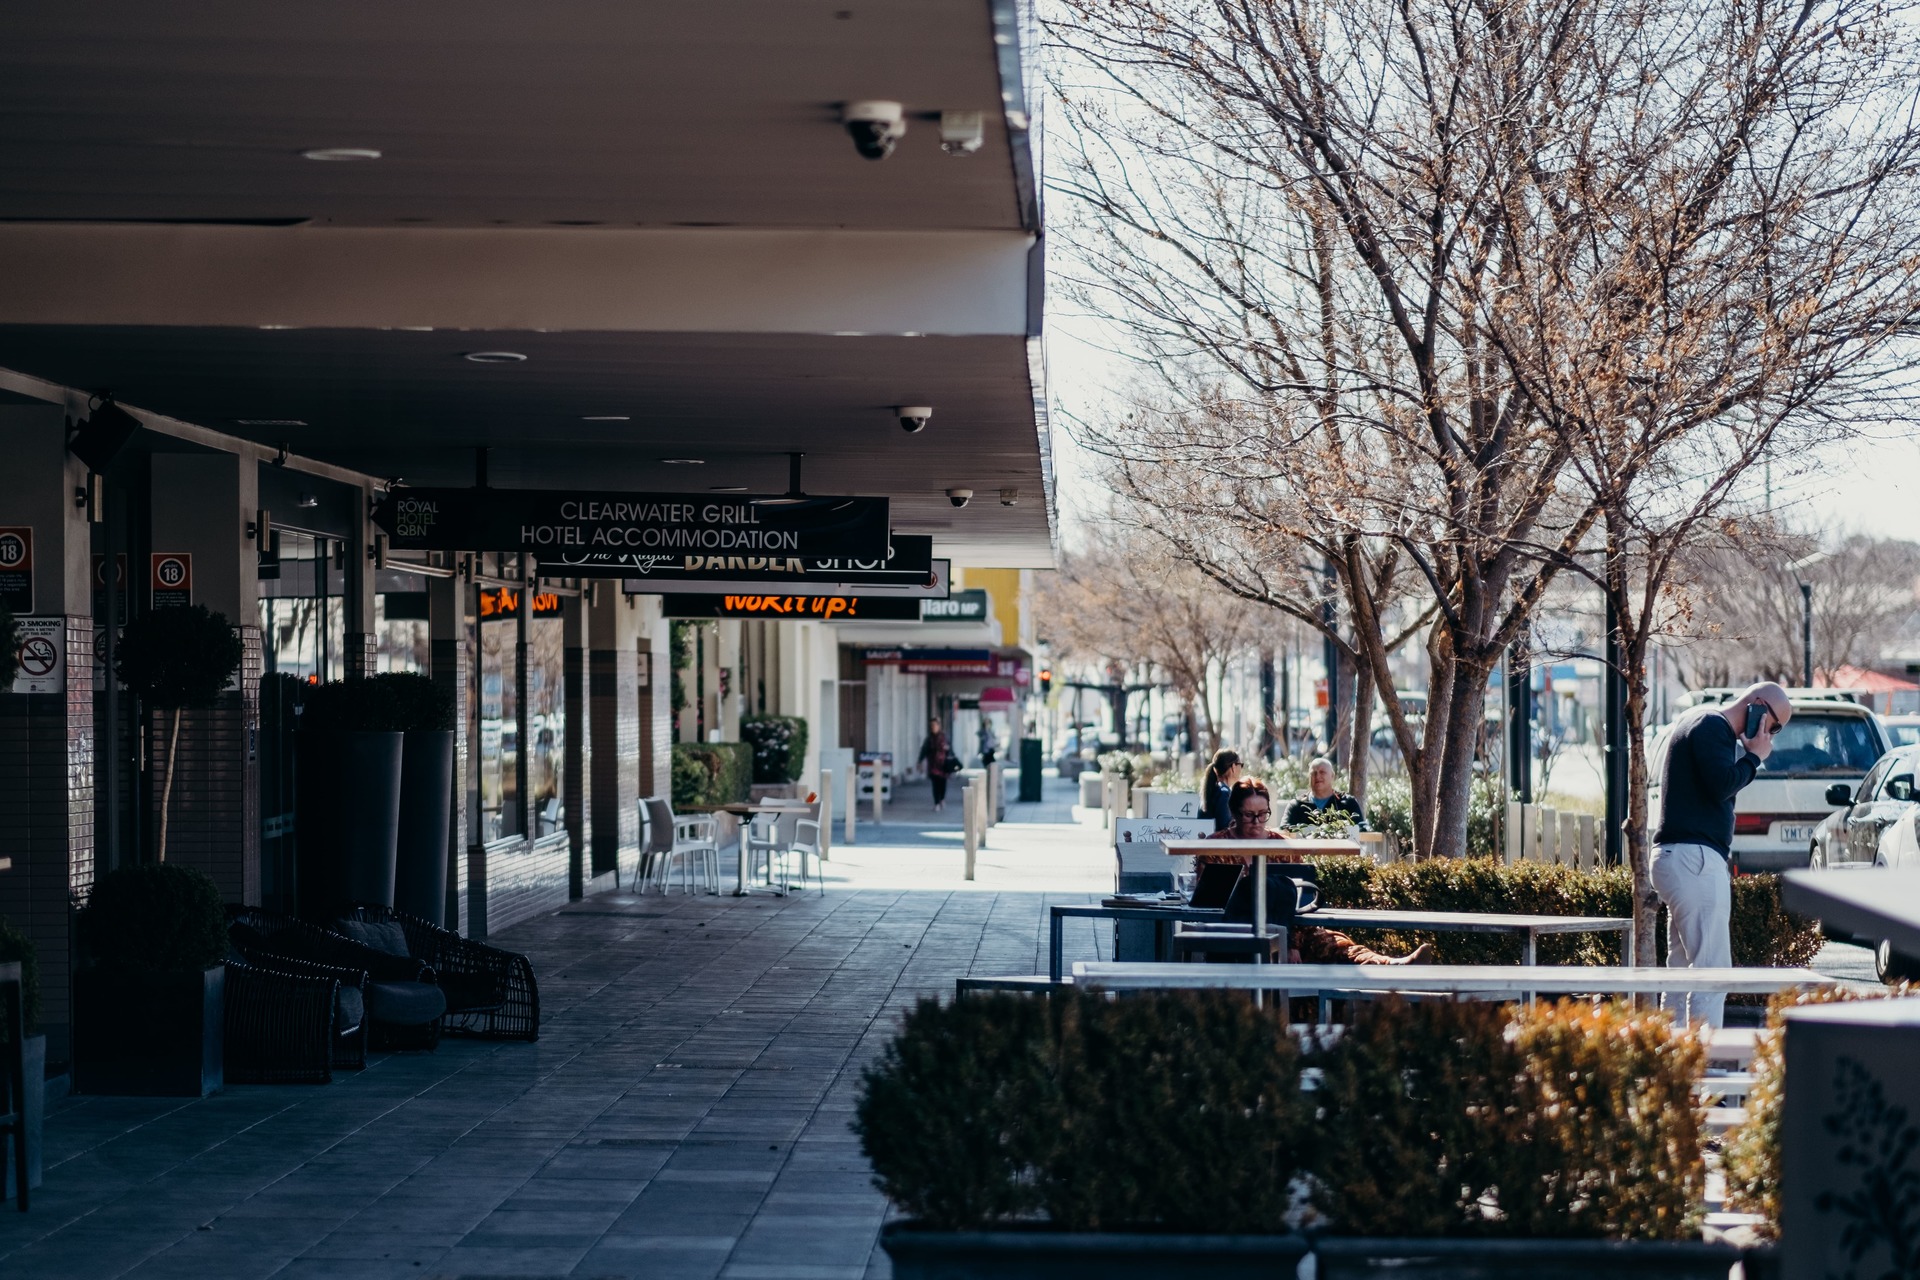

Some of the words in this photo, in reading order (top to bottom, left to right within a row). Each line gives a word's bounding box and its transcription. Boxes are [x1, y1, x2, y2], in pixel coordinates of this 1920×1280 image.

[397, 500, 439, 513] ROYAL
[560, 501, 695, 523] CLEARWATER
[702, 504, 760, 524] GRILL
[397, 512, 437, 525] HOTEL
[397, 524, 428, 537] QBN
[521, 525, 585, 545] HOTEL
[591, 526, 798, 550] ACCOMMODATION
[0, 545, 17, 561] 18
[164, 568, 179, 582] 18
[961, 602, 980, 615] MP
[860, 771, 890, 779] OPN
